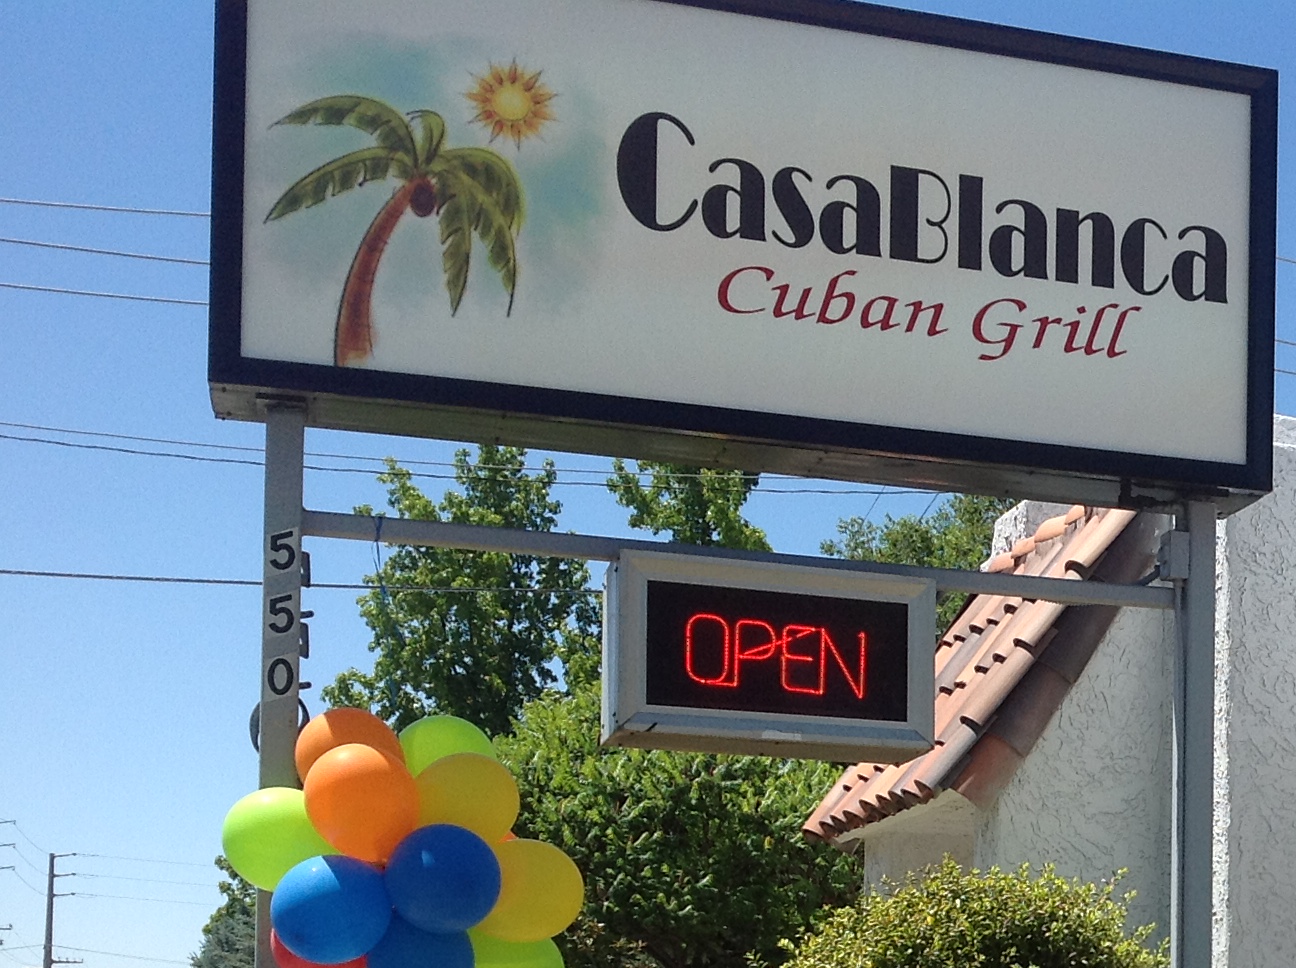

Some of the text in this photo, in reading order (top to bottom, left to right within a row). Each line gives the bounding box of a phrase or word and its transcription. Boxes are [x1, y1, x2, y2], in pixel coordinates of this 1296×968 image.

[616, 111, 1229, 304] CasaBlanca
[715, 265, 1143, 361] Cuban Grill
[685, 612, 867, 699] OPEN
